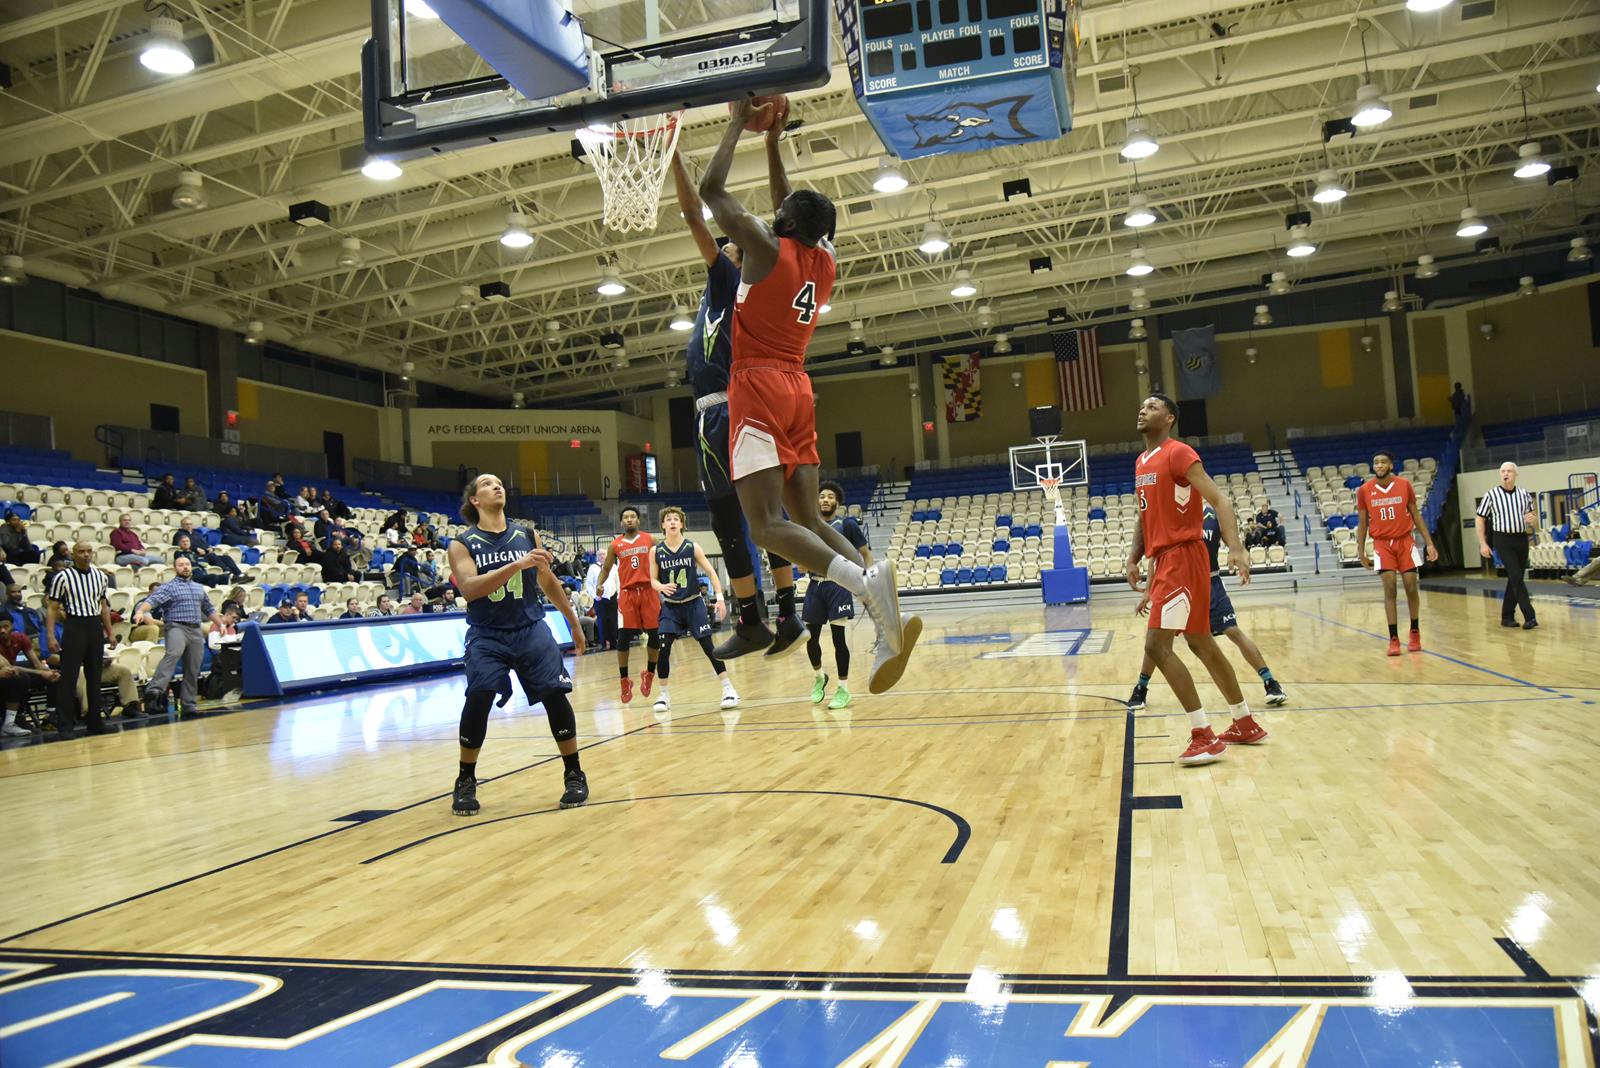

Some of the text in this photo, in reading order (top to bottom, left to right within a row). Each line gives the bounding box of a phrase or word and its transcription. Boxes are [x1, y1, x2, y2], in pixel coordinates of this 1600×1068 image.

[1010, 15, 1040, 29] FOULS
[921, 25, 982, 43] PLAYER FOUL
[865, 39, 893, 52] FOULS
[1013, 54, 1043, 67] SCORE
[939, 65, 970, 79] MATCH
[869, 77, 897, 90] SCORE
[792, 281, 816, 324] 4
[428, 424, 601, 434] APG FEDERAL CREDIT UNION ARENA
[1380, 506, 1395, 520] 11
[631, 555, 640, 569] 3
[660, 557, 692, 570] ALLEGANY
[669, 568, 687, 588] 14
